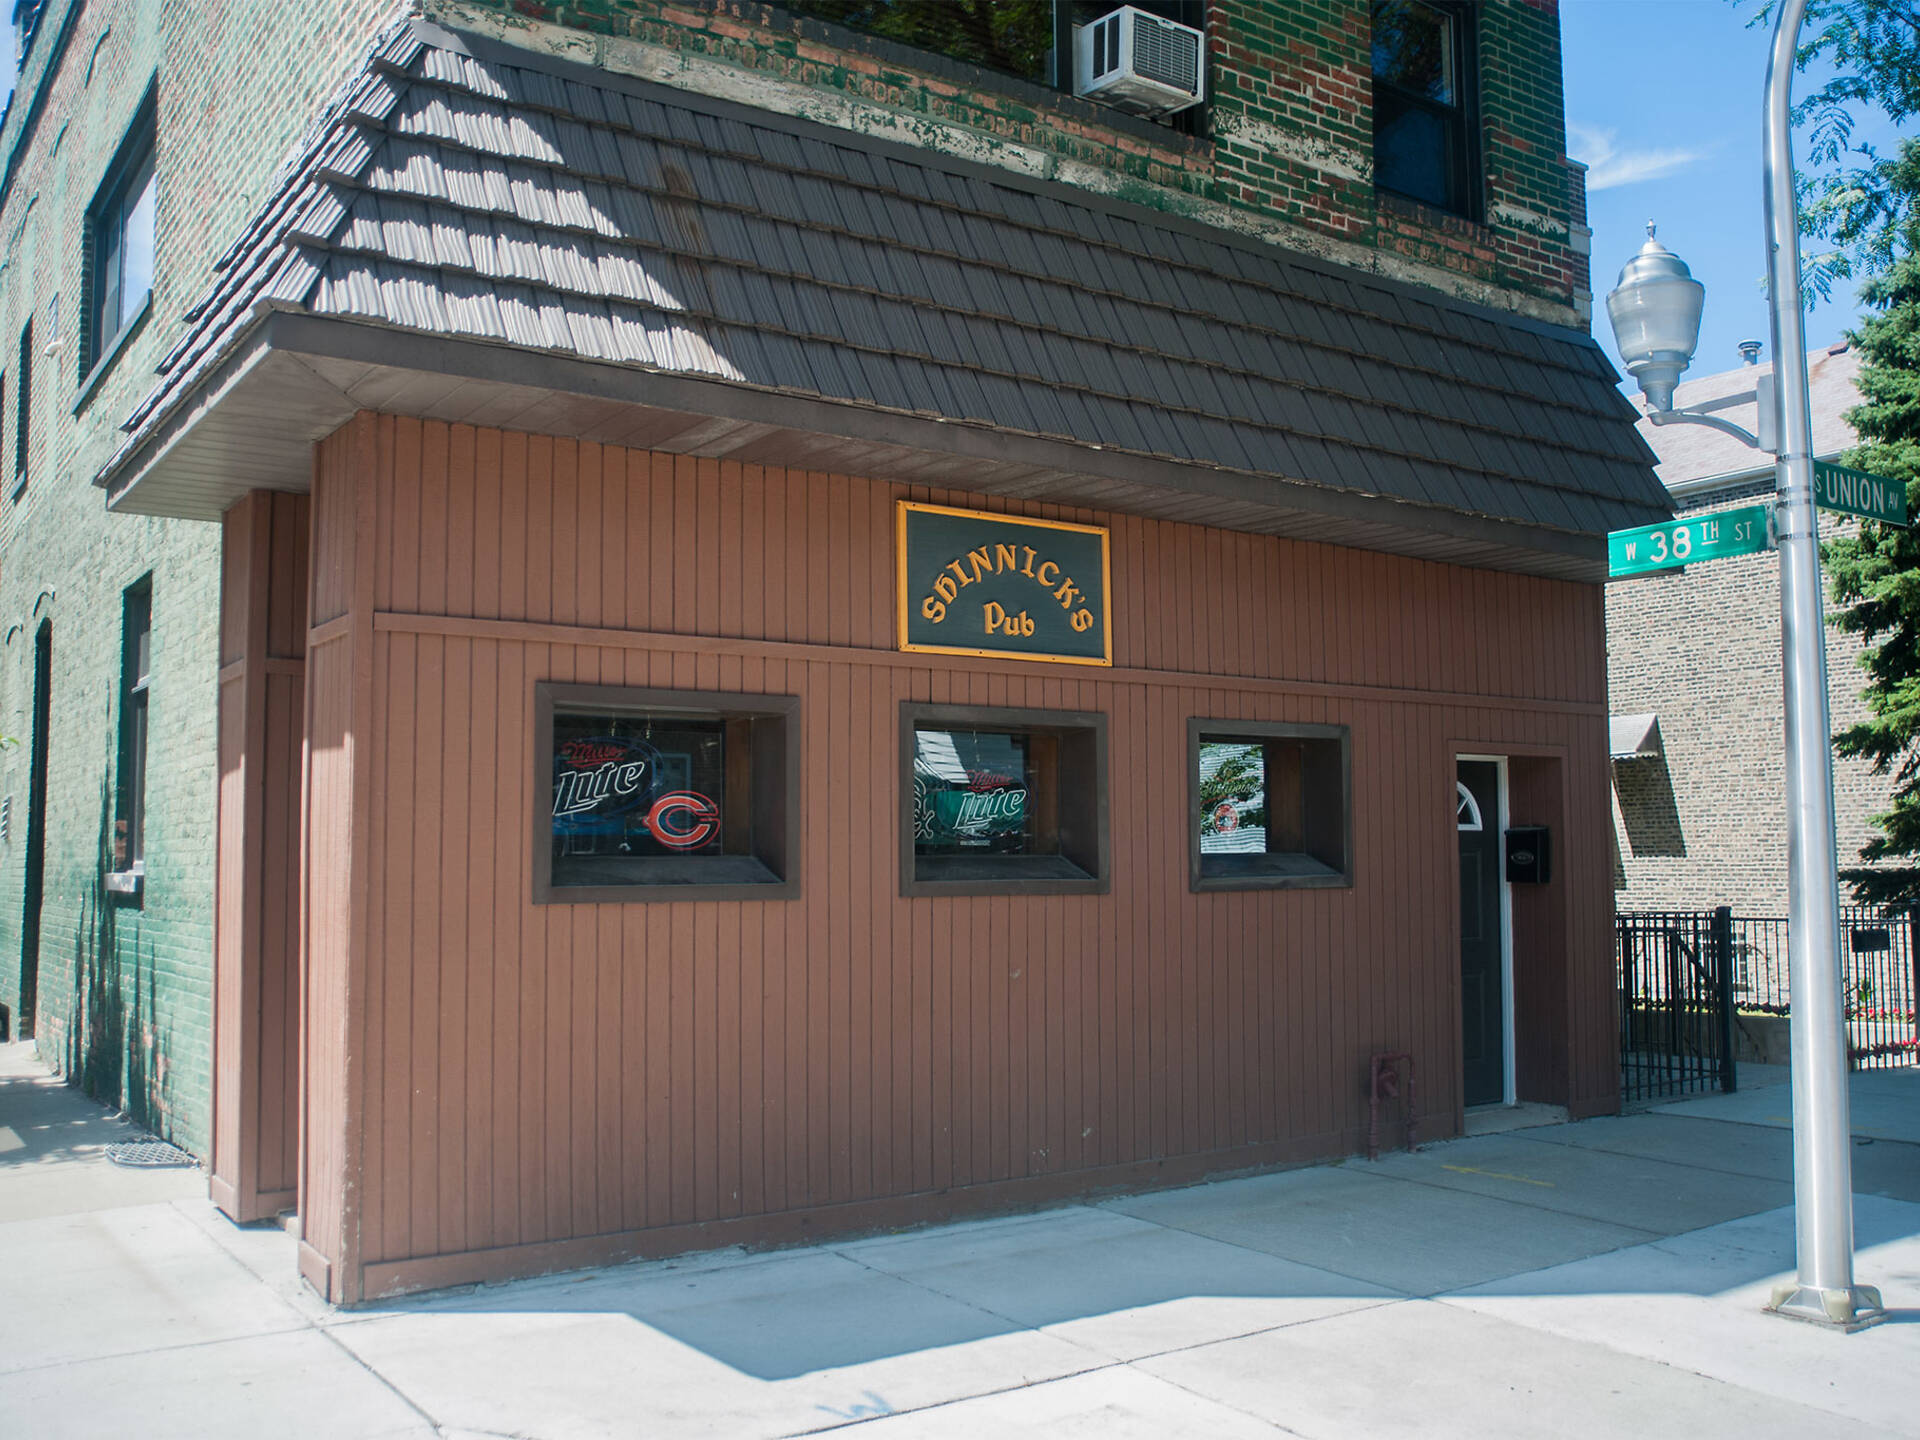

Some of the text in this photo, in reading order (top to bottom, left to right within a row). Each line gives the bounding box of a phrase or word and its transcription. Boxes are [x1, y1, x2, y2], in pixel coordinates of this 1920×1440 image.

[1815, 470, 1899, 514] S UNION AV
[1625, 542, 1637, 561] W
[1735, 521, 1752, 541] ST
[983, 601, 1035, 637] Pub
[560, 742, 627, 768] Miller
[552, 762, 645, 816] Lite
[953, 788, 1027, 829] Lite
